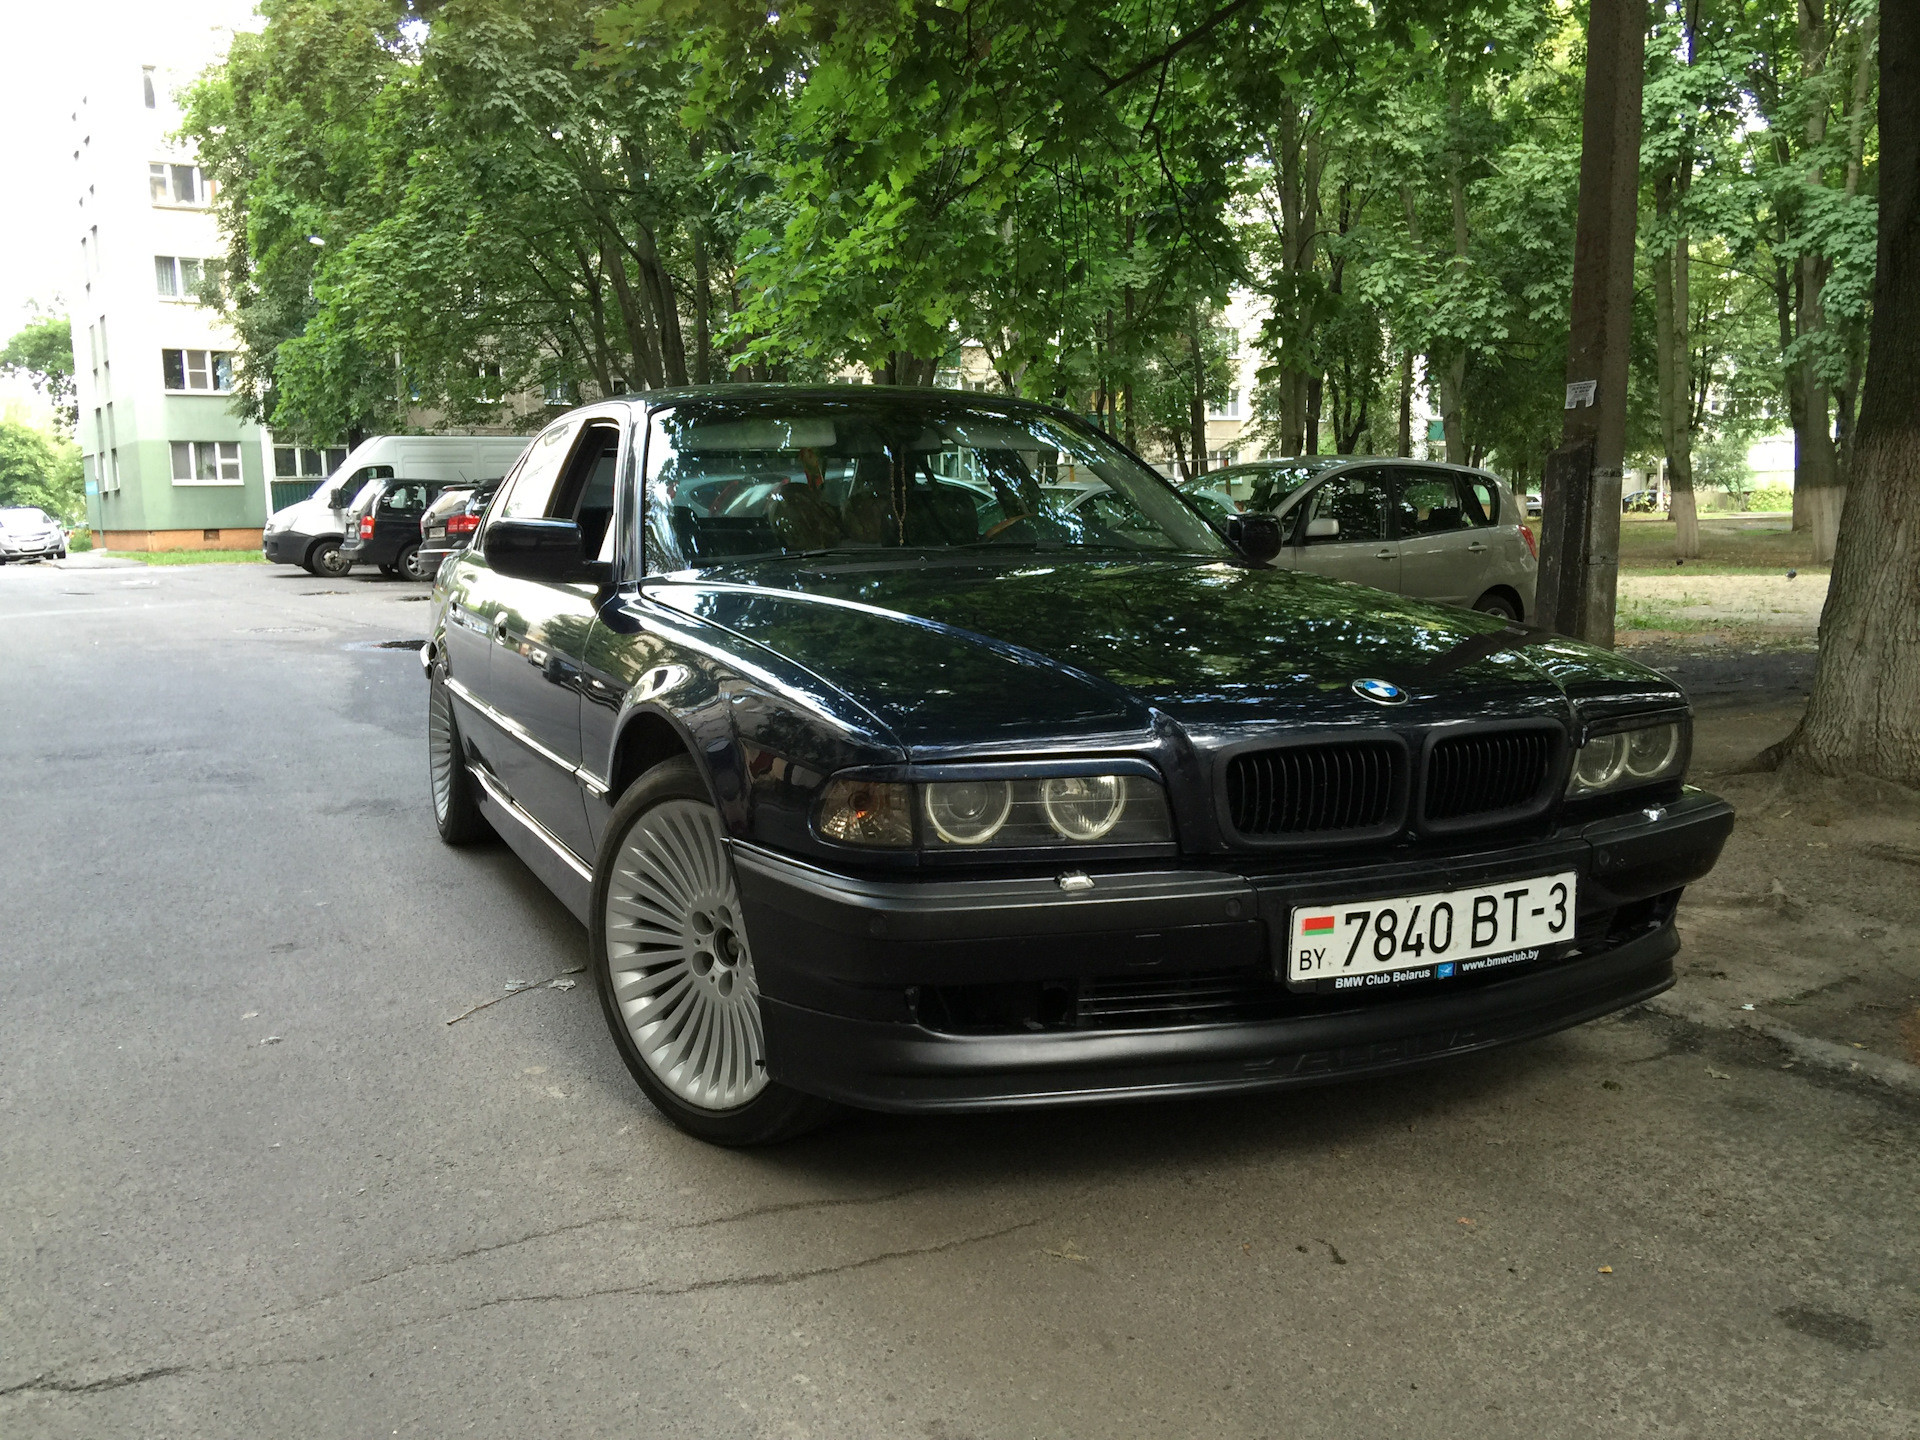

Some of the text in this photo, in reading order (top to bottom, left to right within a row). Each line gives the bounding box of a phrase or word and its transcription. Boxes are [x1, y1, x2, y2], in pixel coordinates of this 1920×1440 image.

[1342, 882, 1568, 967] 7840 BT-3
[1299, 947, 1327, 971] BY
[1461, 949, 1539, 971] www.bmwclub.by
[1335, 968, 1431, 989] BMW Club Belarus
